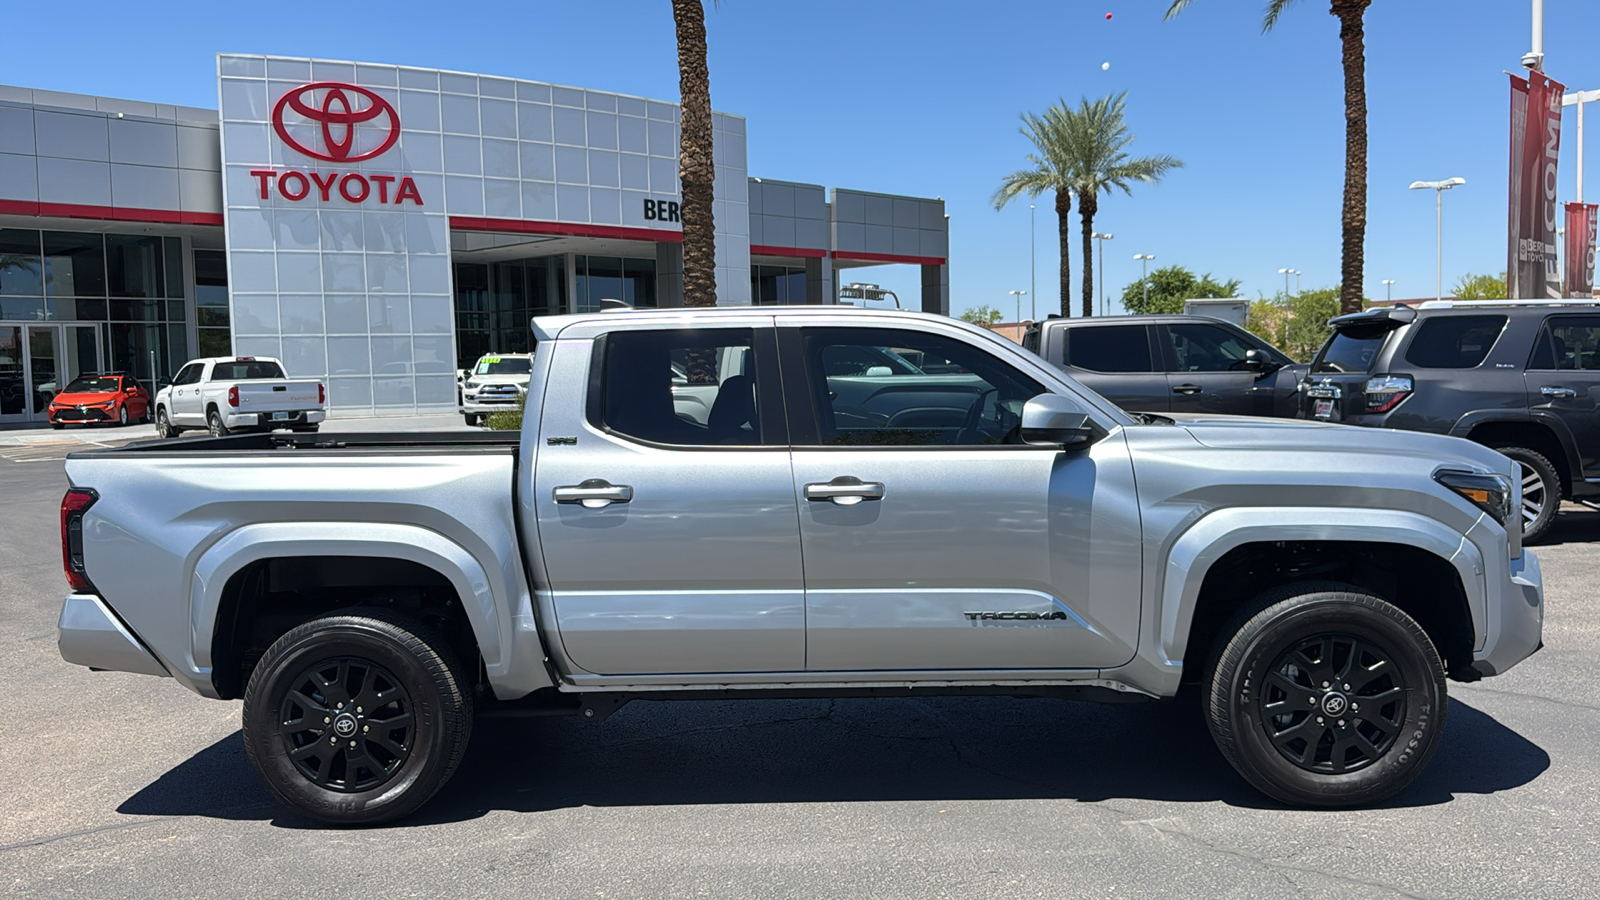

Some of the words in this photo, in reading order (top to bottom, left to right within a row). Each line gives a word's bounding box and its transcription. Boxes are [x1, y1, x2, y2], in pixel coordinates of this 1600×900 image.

[250, 169, 424, 206] TOYOTA
[643, 199, 683, 222] BER
[963, 611, 1067, 621] TACOMA
[1388, 702, 1432, 774] Fireston
